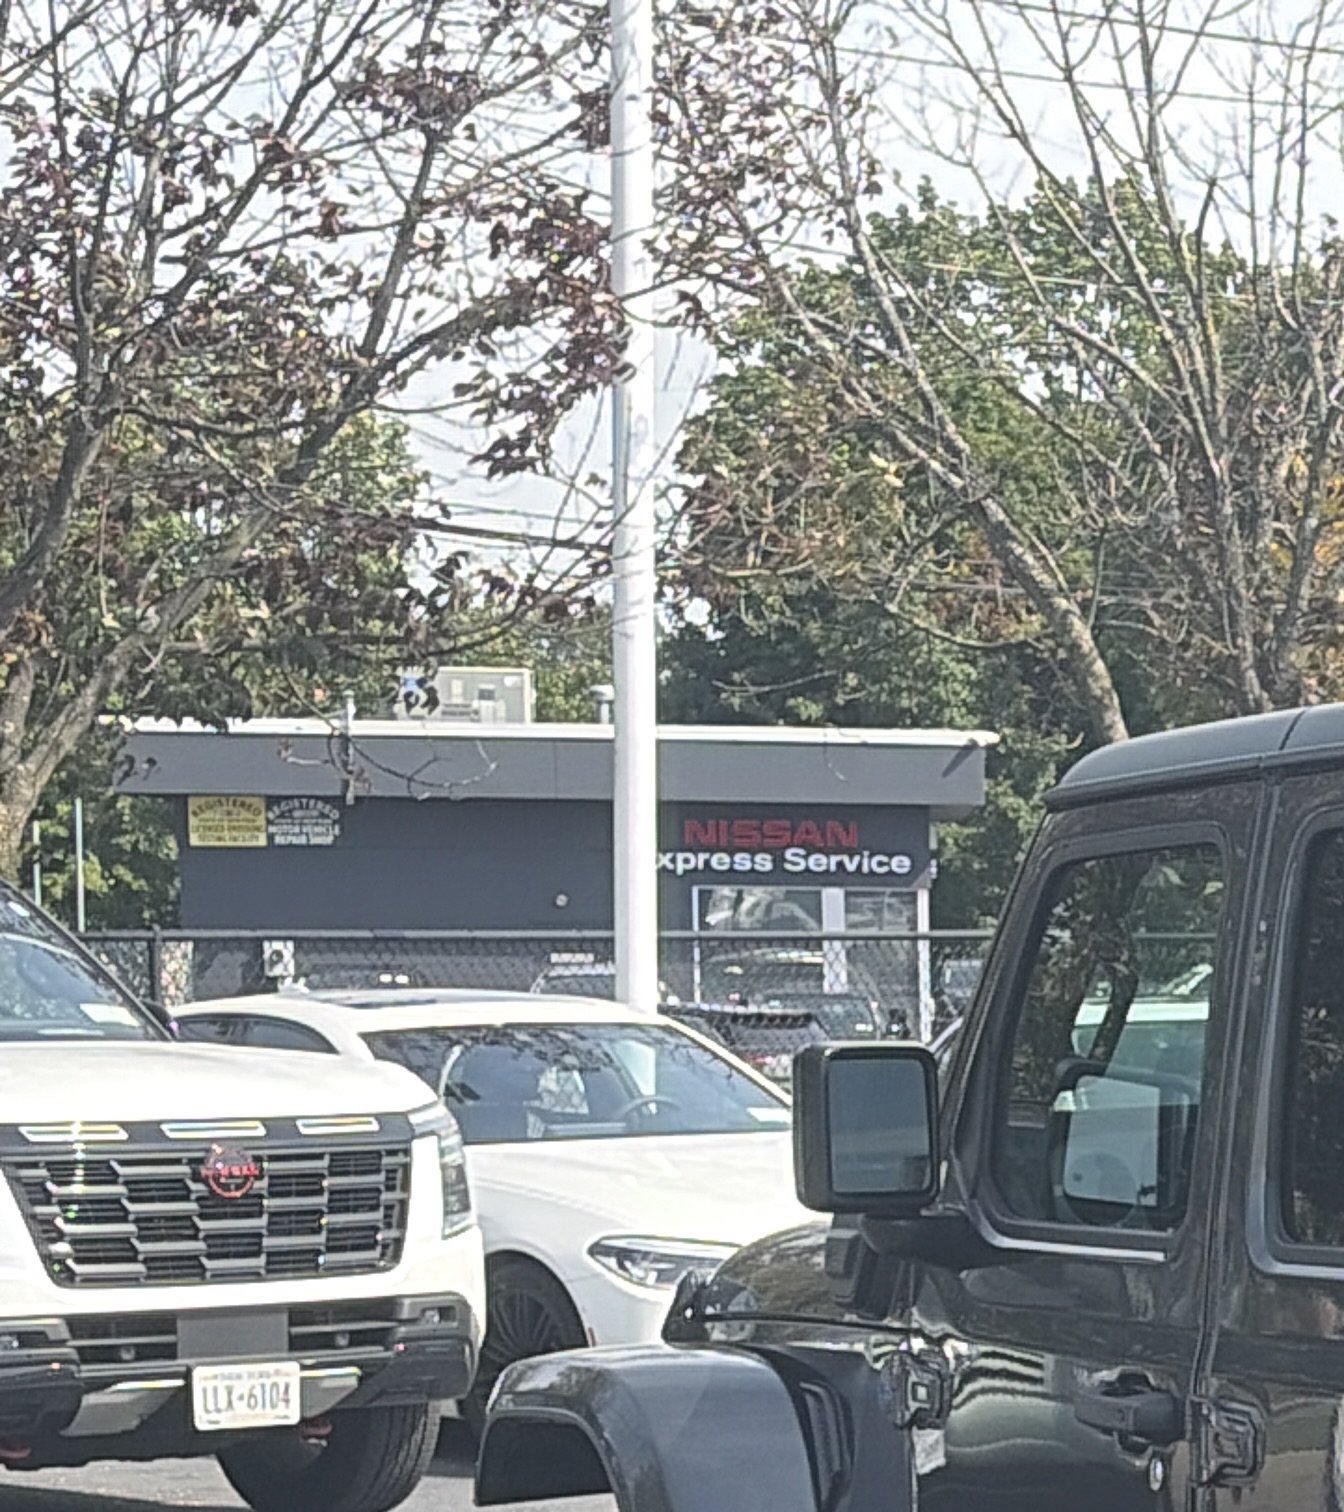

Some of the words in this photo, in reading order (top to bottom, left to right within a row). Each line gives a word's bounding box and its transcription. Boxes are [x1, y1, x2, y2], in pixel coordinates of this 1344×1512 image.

[684, 819, 859, 848] NISSAN
[656, 850, 774, 876] xpress
[783, 847, 912, 874] Service
